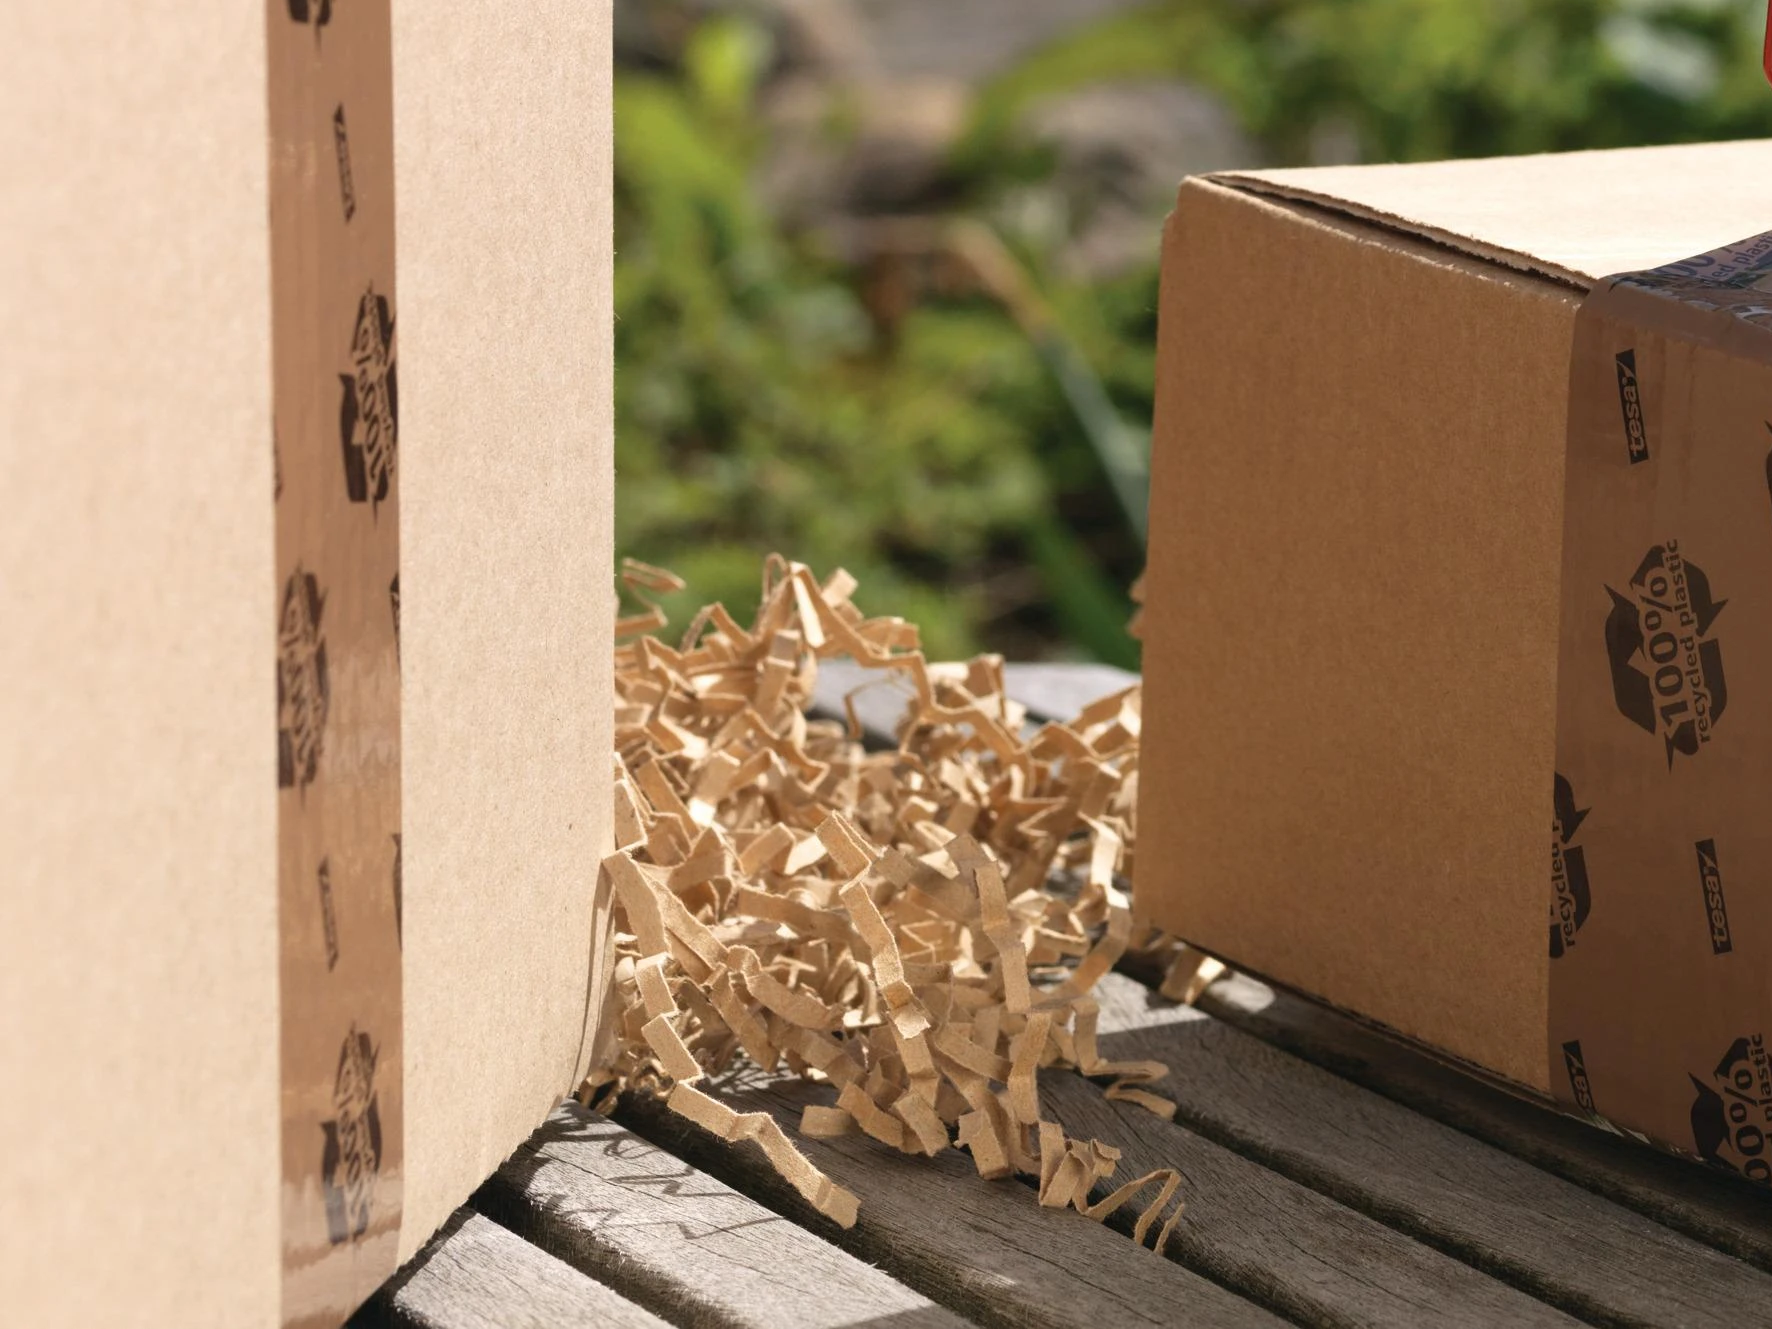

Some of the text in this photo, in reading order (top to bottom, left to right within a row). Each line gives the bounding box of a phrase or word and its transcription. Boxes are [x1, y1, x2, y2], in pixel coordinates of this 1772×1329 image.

[1622, 377, 1645, 457] tesa
[1637, 575, 1689, 728] 100%
[1666, 538, 1712, 744] recycled plastic
[1703, 867, 1728, 949] tesa
